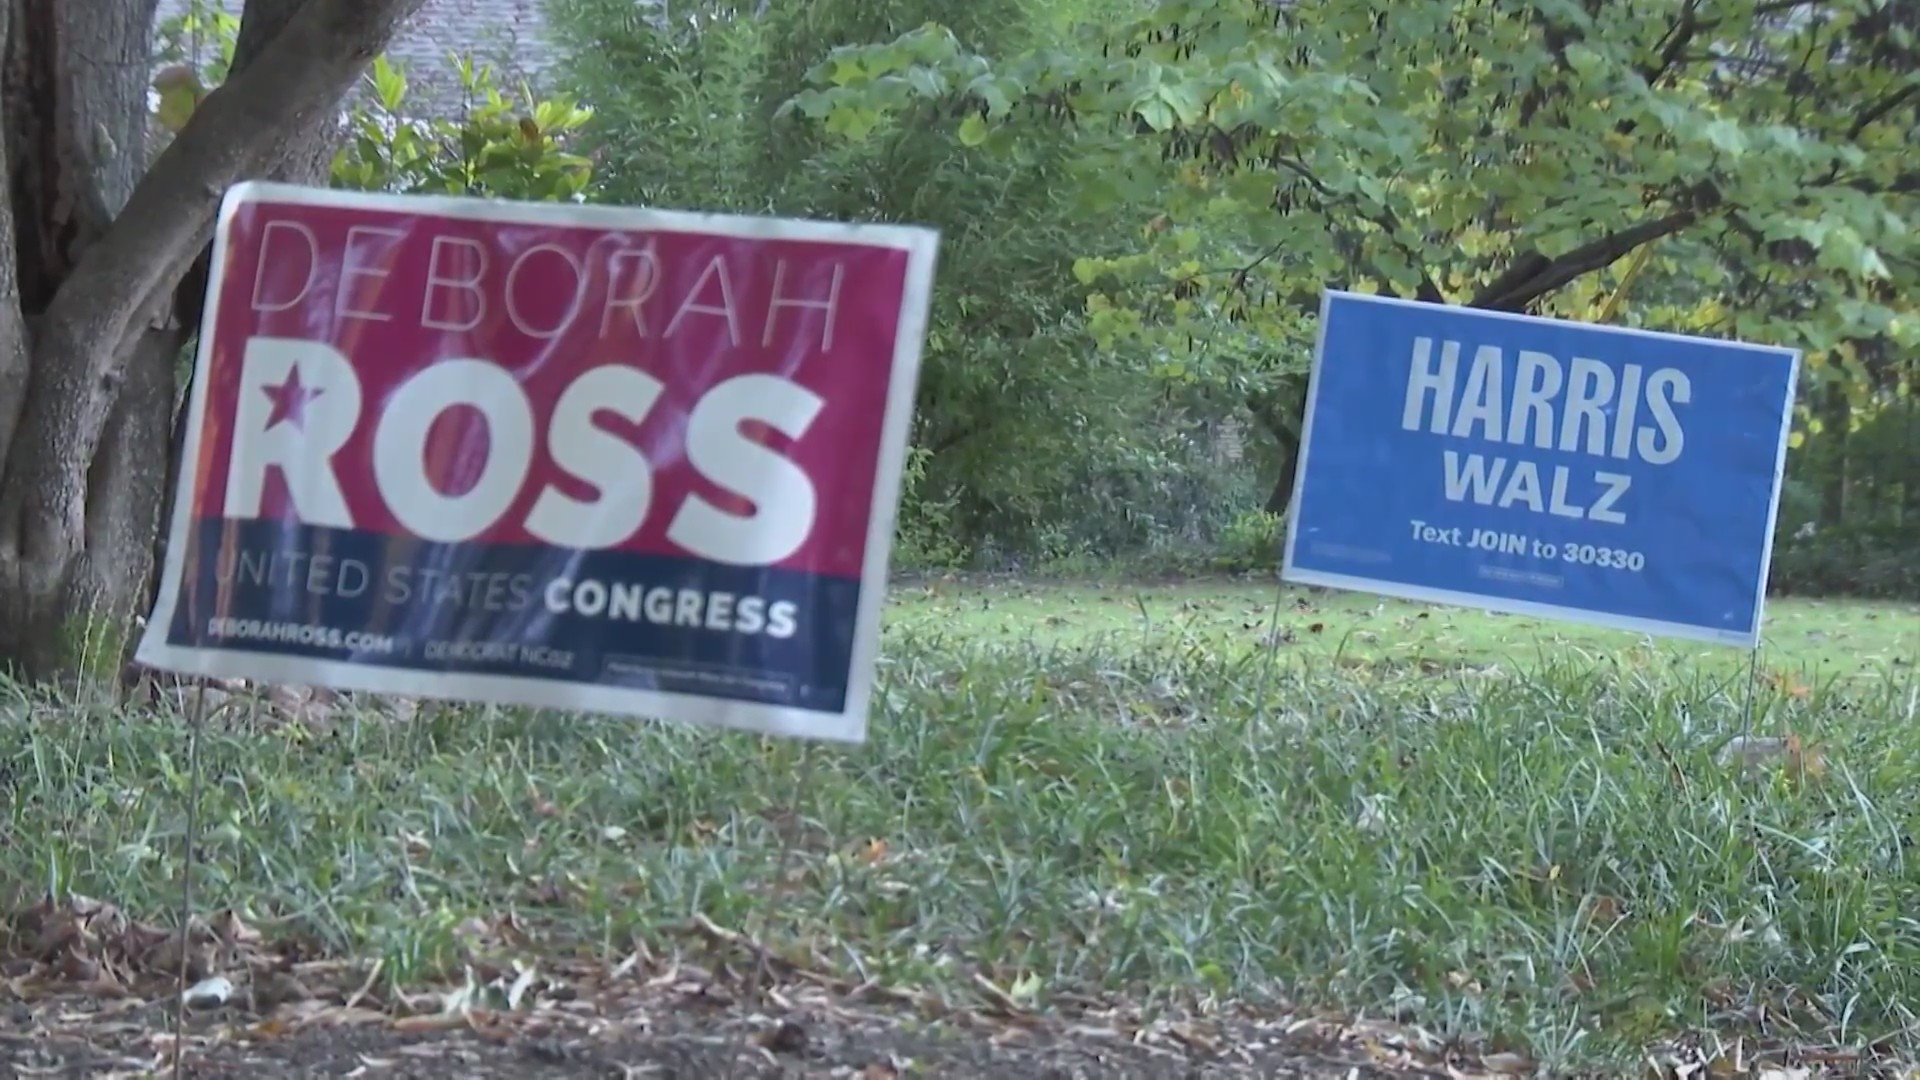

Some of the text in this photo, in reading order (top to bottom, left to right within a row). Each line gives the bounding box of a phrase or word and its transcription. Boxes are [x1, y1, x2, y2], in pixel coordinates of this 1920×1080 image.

[251, 220, 844, 353] DEBORAH
[1401, 336, 1691, 465] HARRIS
[224, 336, 826, 566] ROSS
[1443, 450, 1632, 525] WALZ
[1410, 519, 1645, 572] Text JOIN to 30330
[207, 617, 394, 655] DEBORAHROSS.COM
[215, 549, 798, 639] UNITED STATES CONGRESS
